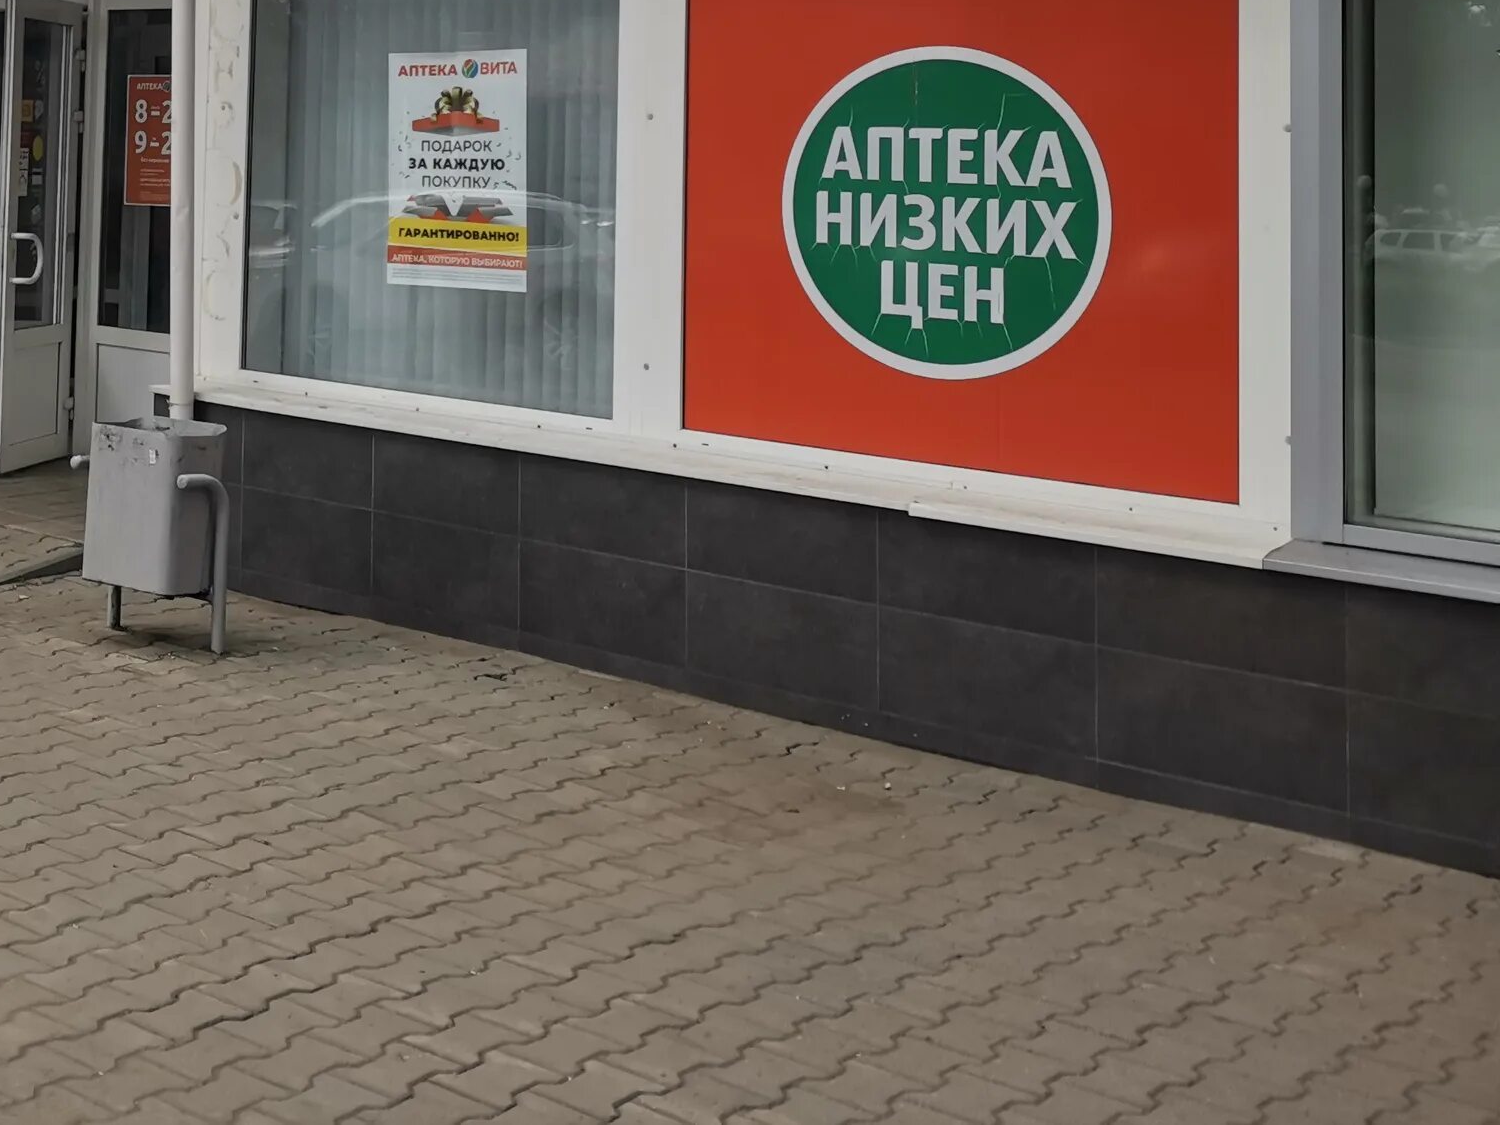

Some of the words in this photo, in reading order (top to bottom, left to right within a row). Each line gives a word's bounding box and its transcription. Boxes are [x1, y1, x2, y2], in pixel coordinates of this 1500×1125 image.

[397, 64, 458, 77] АПТЕКА
[480, 61, 518, 75] ВИТА
[136, 82, 163, 91] АПТЕКА
[421, 139, 492, 154] ПОДАРОК
[820, 125, 1072, 188] АПТЕКА
[408, 158, 428, 170] ЗА
[433, 158, 505, 172] КАЖДУЮ
[421, 175, 491, 189] ПОКУПКУ
[816, 190, 1079, 260] НИЗКИХ
[398, 227, 520, 242] ГАРАНТИРОВАННО!
[391, 254, 427, 264] АПТЕКА,
[428, 255, 470, 266] КОТОРУЮ
[471, 257, 523, 268] ВЫБИРАЮТ!
[880, 259, 1005, 329] ЦЕН
